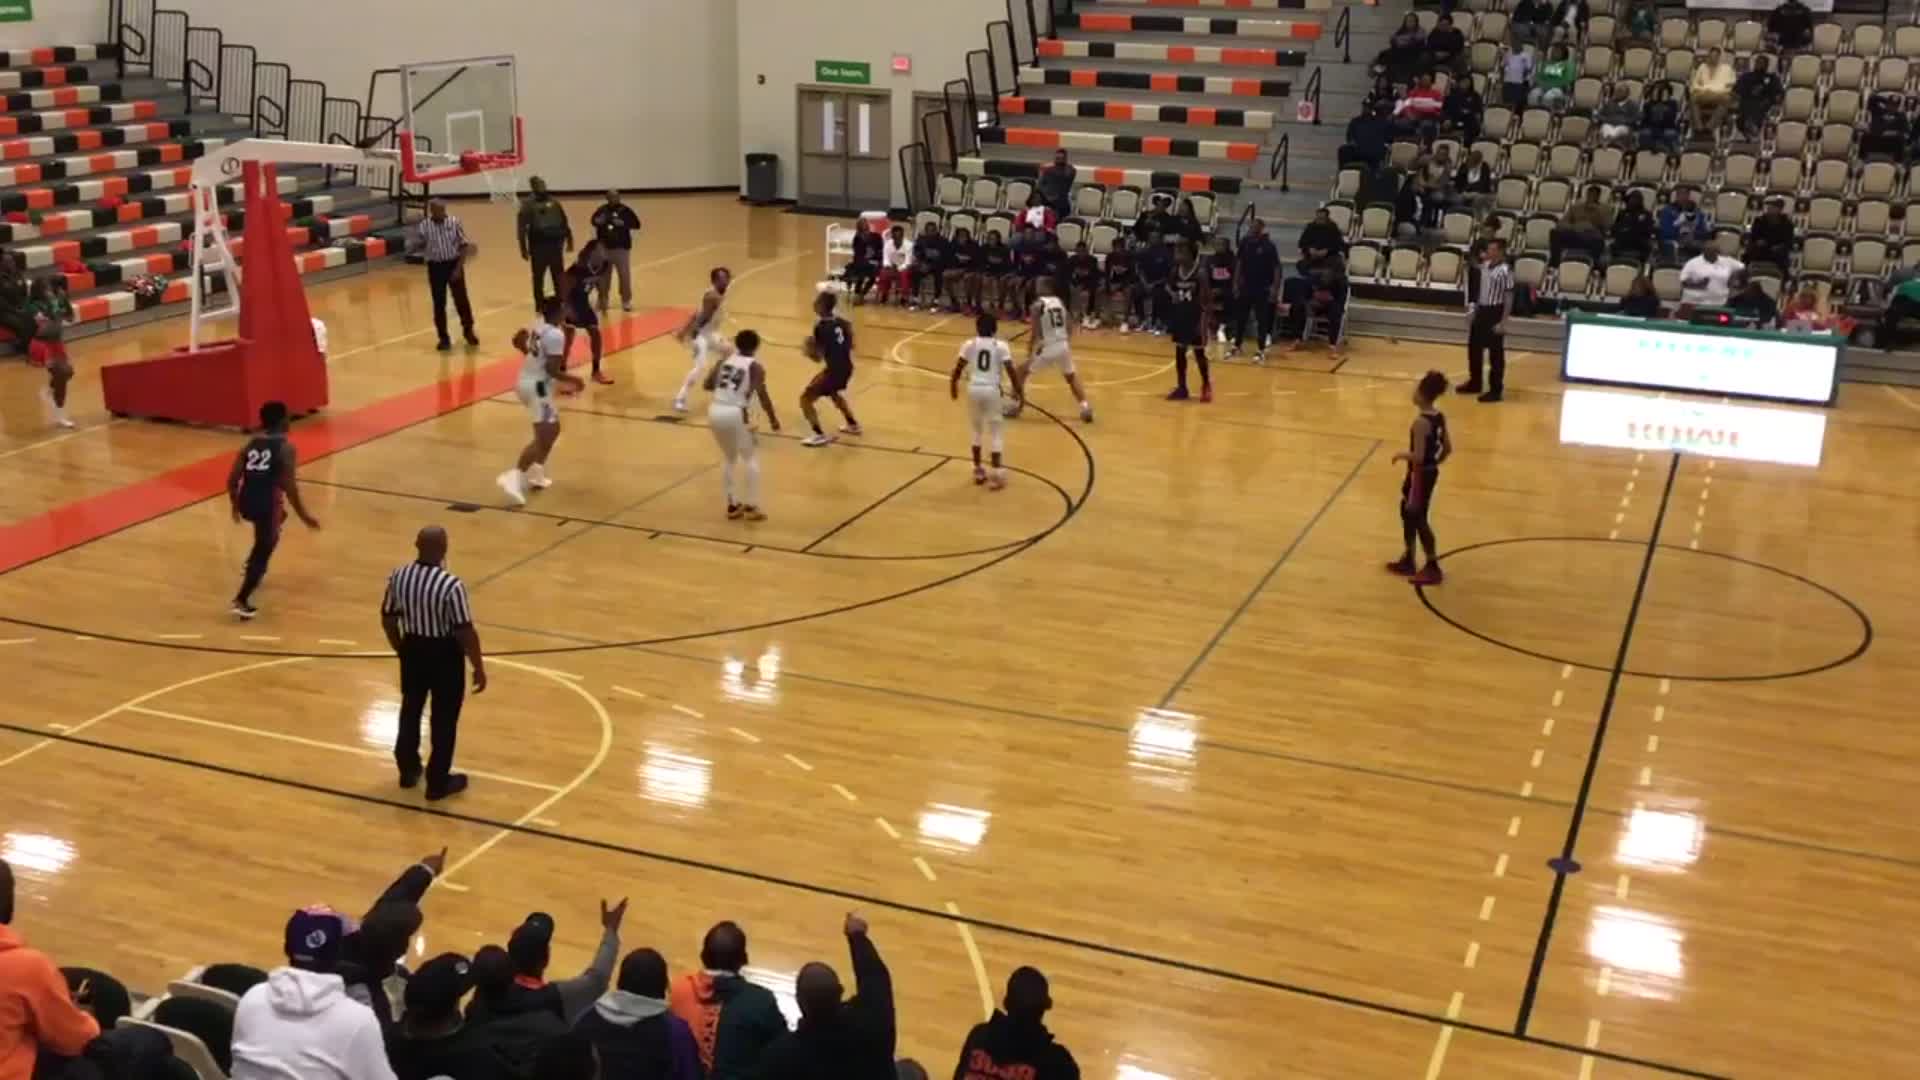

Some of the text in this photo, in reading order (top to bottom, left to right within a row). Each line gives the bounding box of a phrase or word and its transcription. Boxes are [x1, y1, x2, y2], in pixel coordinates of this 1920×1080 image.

[1050, 307, 1065, 328] 13
[977, 349, 991, 372] 0
[246, 448, 272, 471] 22
